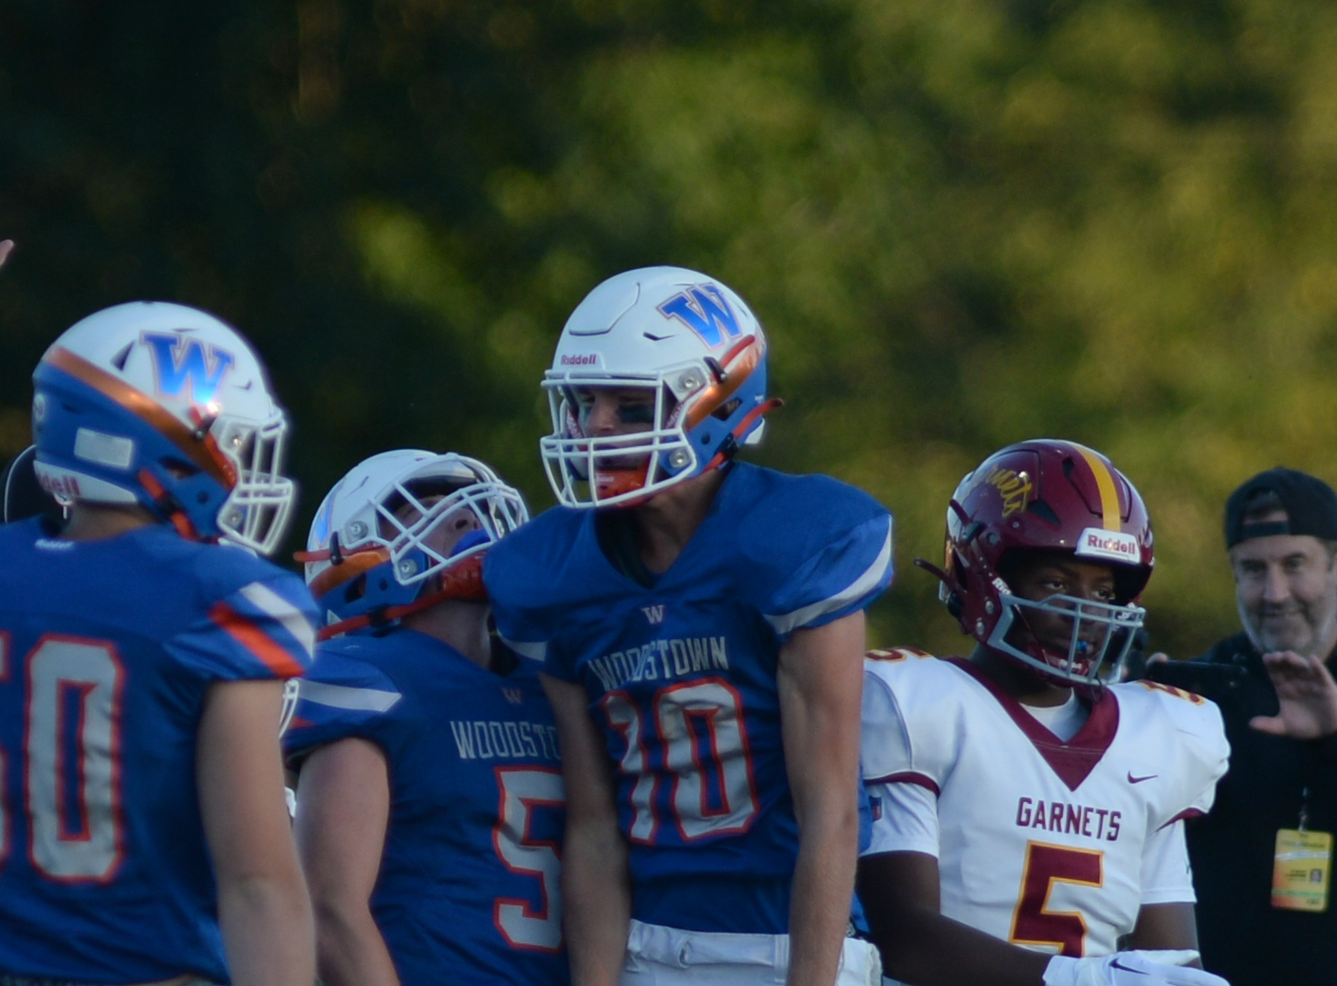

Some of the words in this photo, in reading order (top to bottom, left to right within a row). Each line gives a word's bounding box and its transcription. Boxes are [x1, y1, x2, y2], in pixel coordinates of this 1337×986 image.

[655, 282, 742, 352] W
[139, 330, 235, 407] W
[1087, 534, 1136, 556] Riddell
[641, 604, 665, 624] W
[598, 675, 760, 846] 10
[1016, 796, 1122, 842] GARNETS
[492, 765, 566, 955] 5
[1009, 838, 1105, 958] 5
